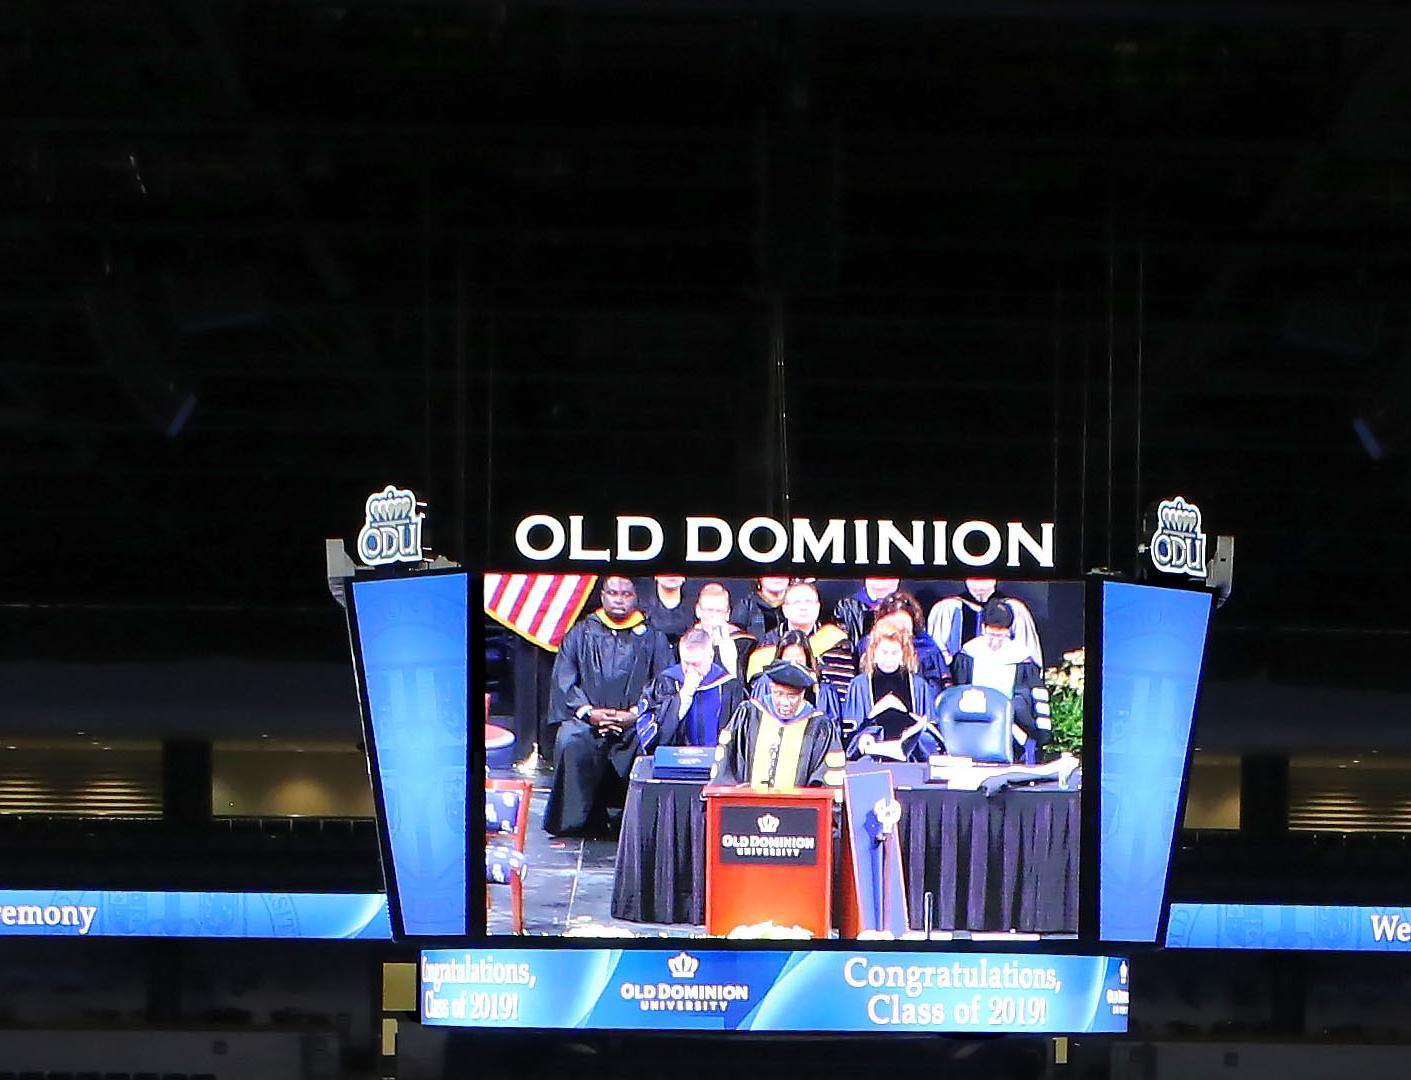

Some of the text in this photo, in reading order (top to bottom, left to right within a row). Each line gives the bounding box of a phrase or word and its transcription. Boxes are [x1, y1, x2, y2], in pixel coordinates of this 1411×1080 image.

[359, 523, 421, 563] ODU
[515, 514, 1055, 567] OLD DOMINION
[1152, 533, 1205, 573] ODU
[721, 834, 815, 850] OLD DOMINION
[620, 983, 749, 1001] OLD DOMINION
[844, 957, 1062, 996] Congratulations,
[452, 990, 467, 1018] of
[470, 992, 519, 1020] 2019!
[640, 1000, 729, 1012] UNIVERSITY
[868, 994, 1047, 1026] Class of 2019!
